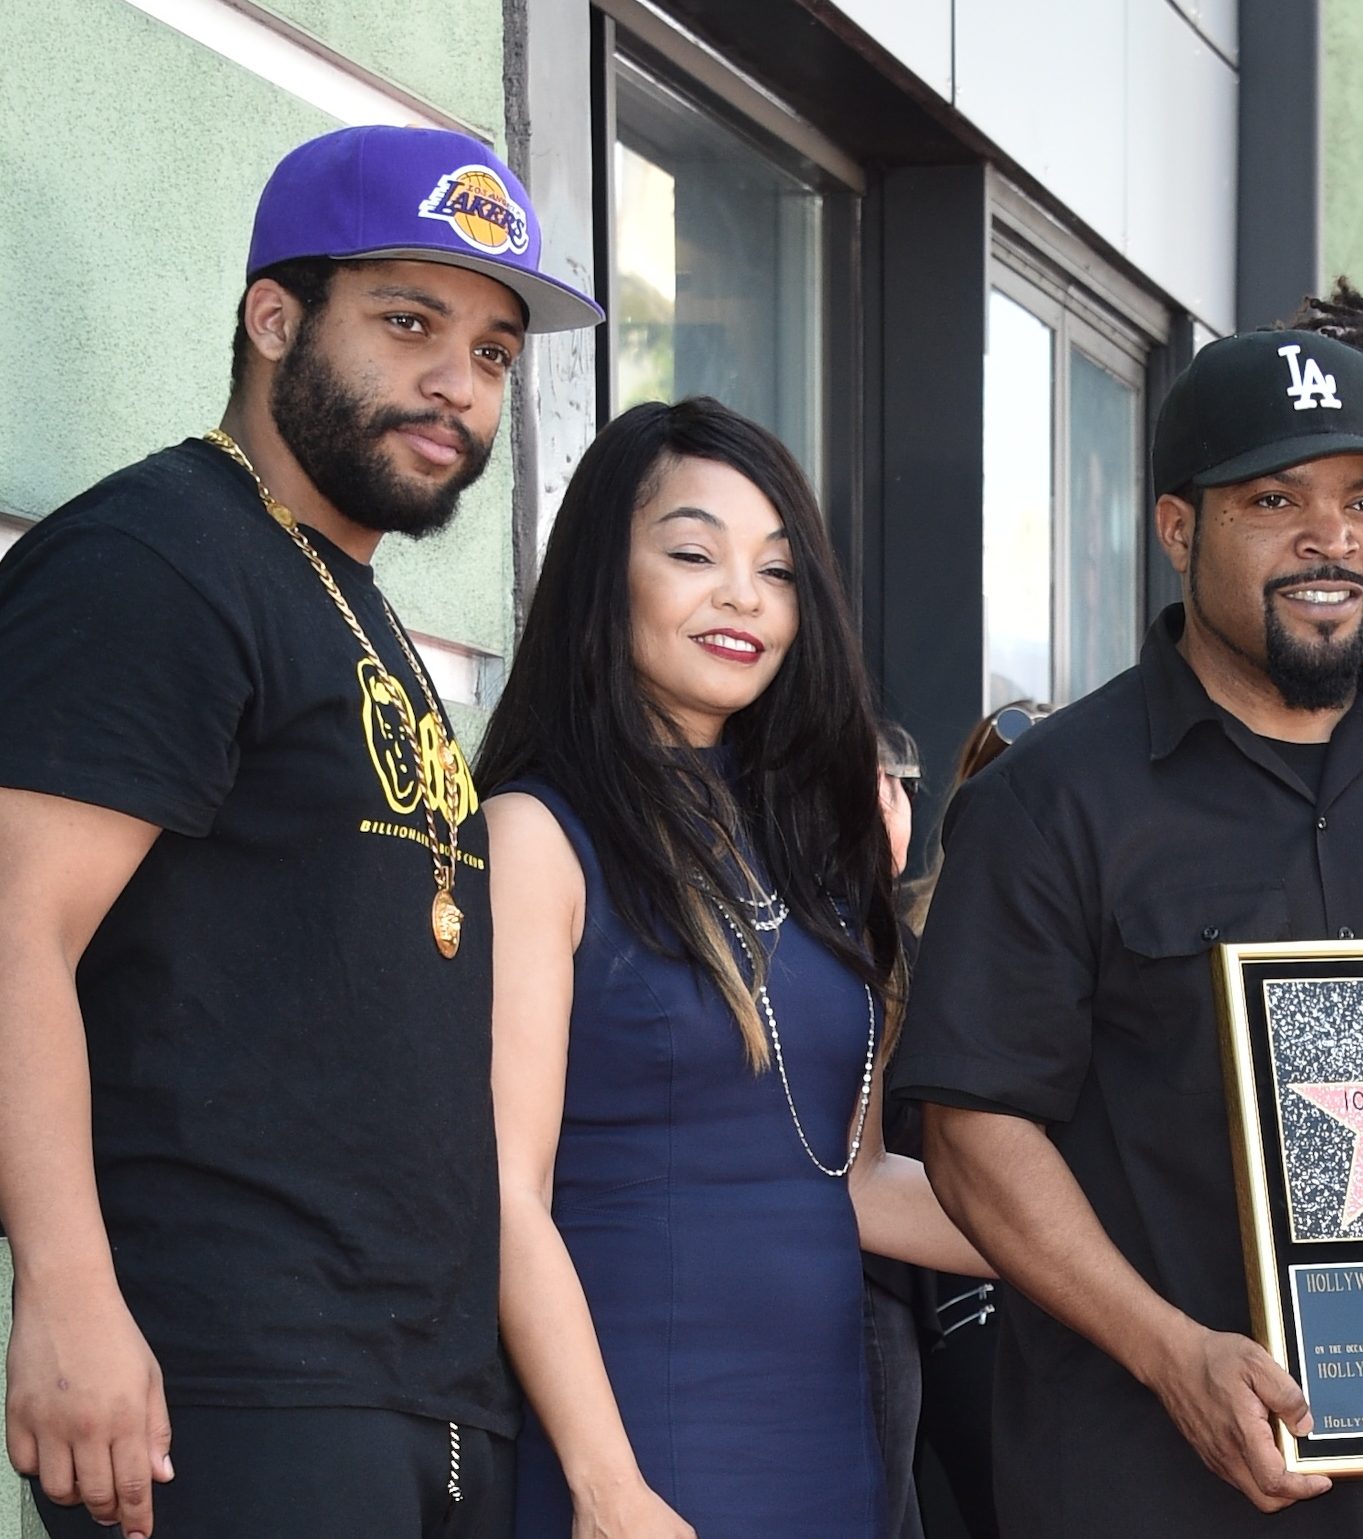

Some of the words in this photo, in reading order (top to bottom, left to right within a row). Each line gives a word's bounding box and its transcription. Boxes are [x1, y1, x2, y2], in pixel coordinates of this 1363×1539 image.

[427, 179, 527, 249] LAKERS
[1277, 344, 1343, 411] LA
[359, 819, 432, 848] BILLIONAIR
[439, 842, 462, 861] BOS
[463, 853, 485, 870] CLUB
[1314, 1345, 1325, 1355] ON
[1329, 1344, 1342, 1354] THE
